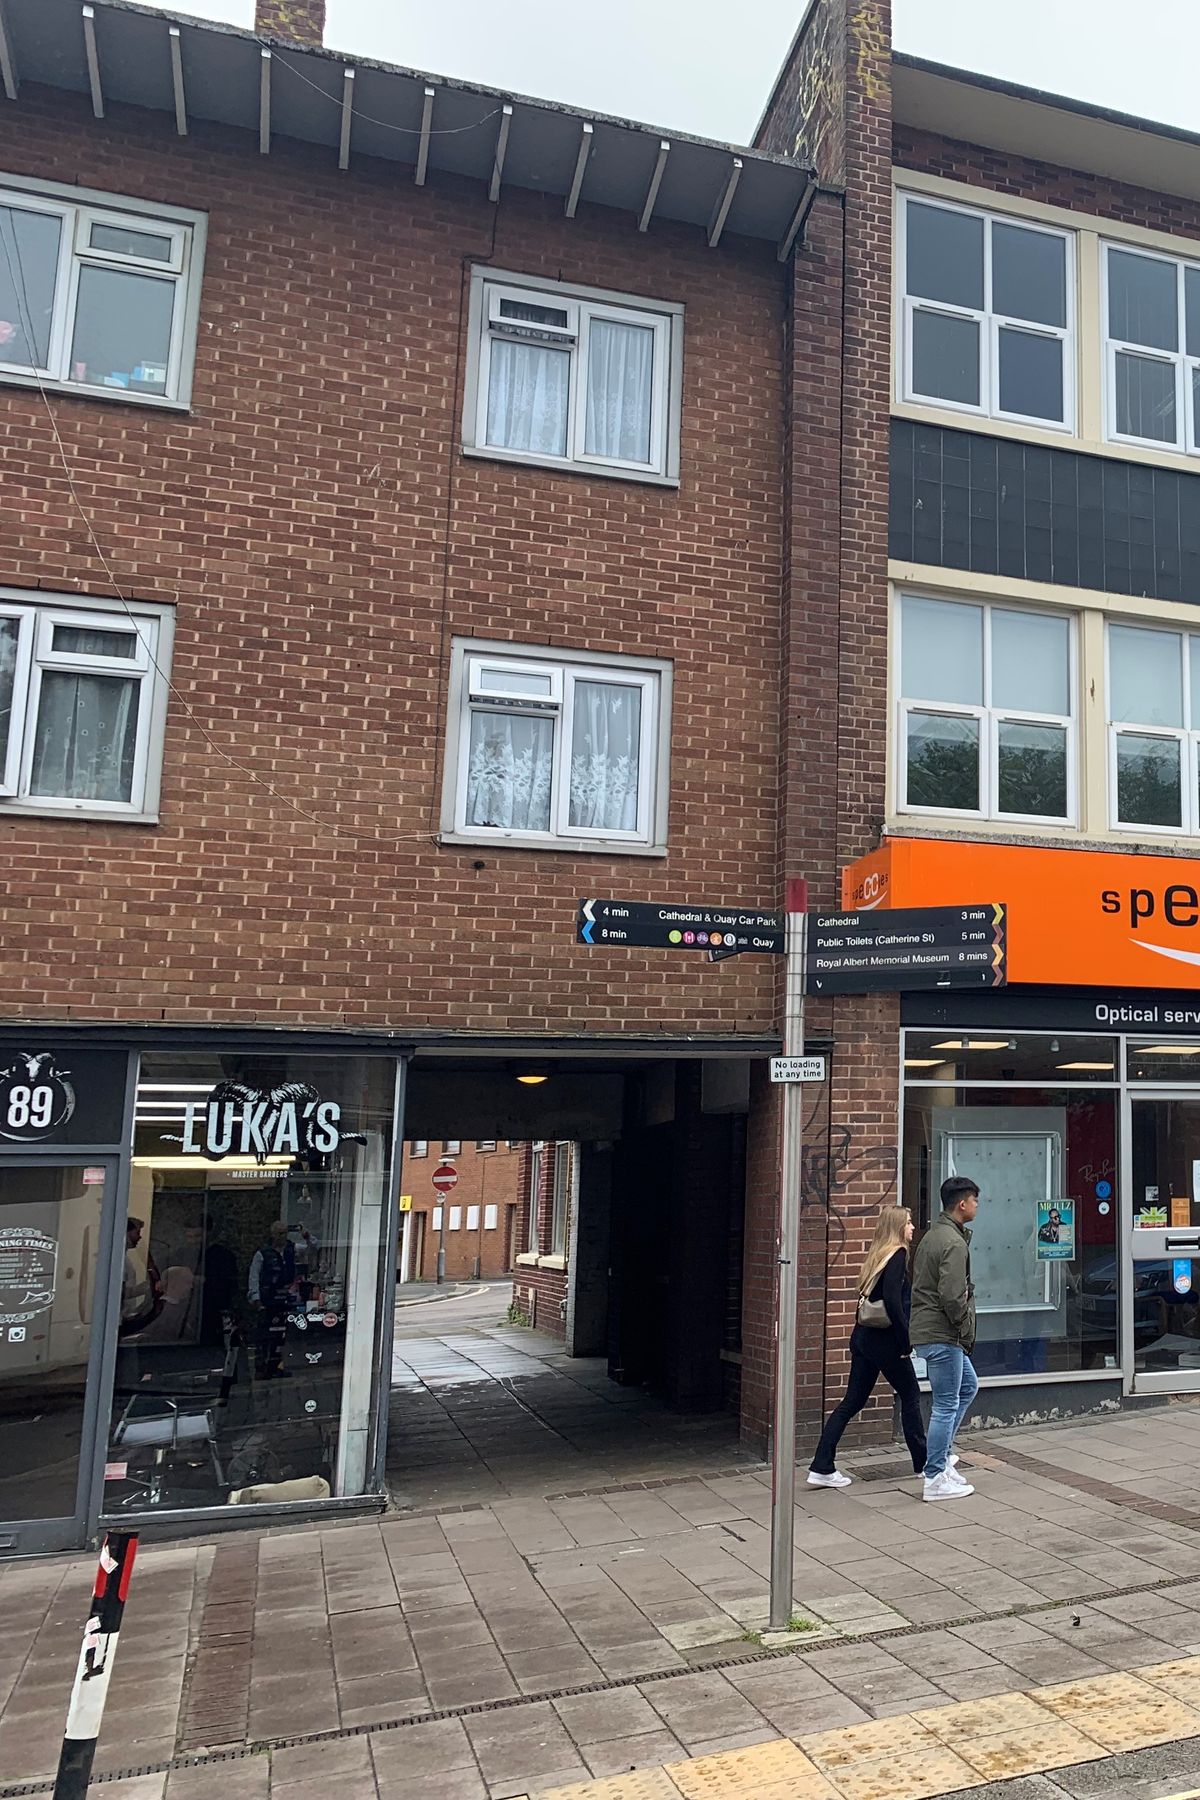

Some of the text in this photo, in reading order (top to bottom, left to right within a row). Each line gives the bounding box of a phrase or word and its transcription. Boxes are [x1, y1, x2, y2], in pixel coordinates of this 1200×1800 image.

[602, 908, 776, 926] 4 min Cathedral & Quay Car Park
[817, 911, 986, 928] Cathedral 3 min
[602, 930, 774, 948] 8 min Quay
[817, 931, 986, 947] Public Toilets (Catherine St) 5 min
[816, 952, 988, 970] Royal Albert Memorial Museum 8 mins
[1095, 1004, 1158, 1024] Optical
[776, 1060, 820, 1070] No loading
[786, 1071, 800, 1079] any
[804, 1070, 821, 1078] time
[6, 1086, 53, 1128] 89
[182, 1102, 340, 1153] LUKA'S
[260, 1170, 288, 1178] BARBERS
[24, 1239, 54, 1250] TIMES
